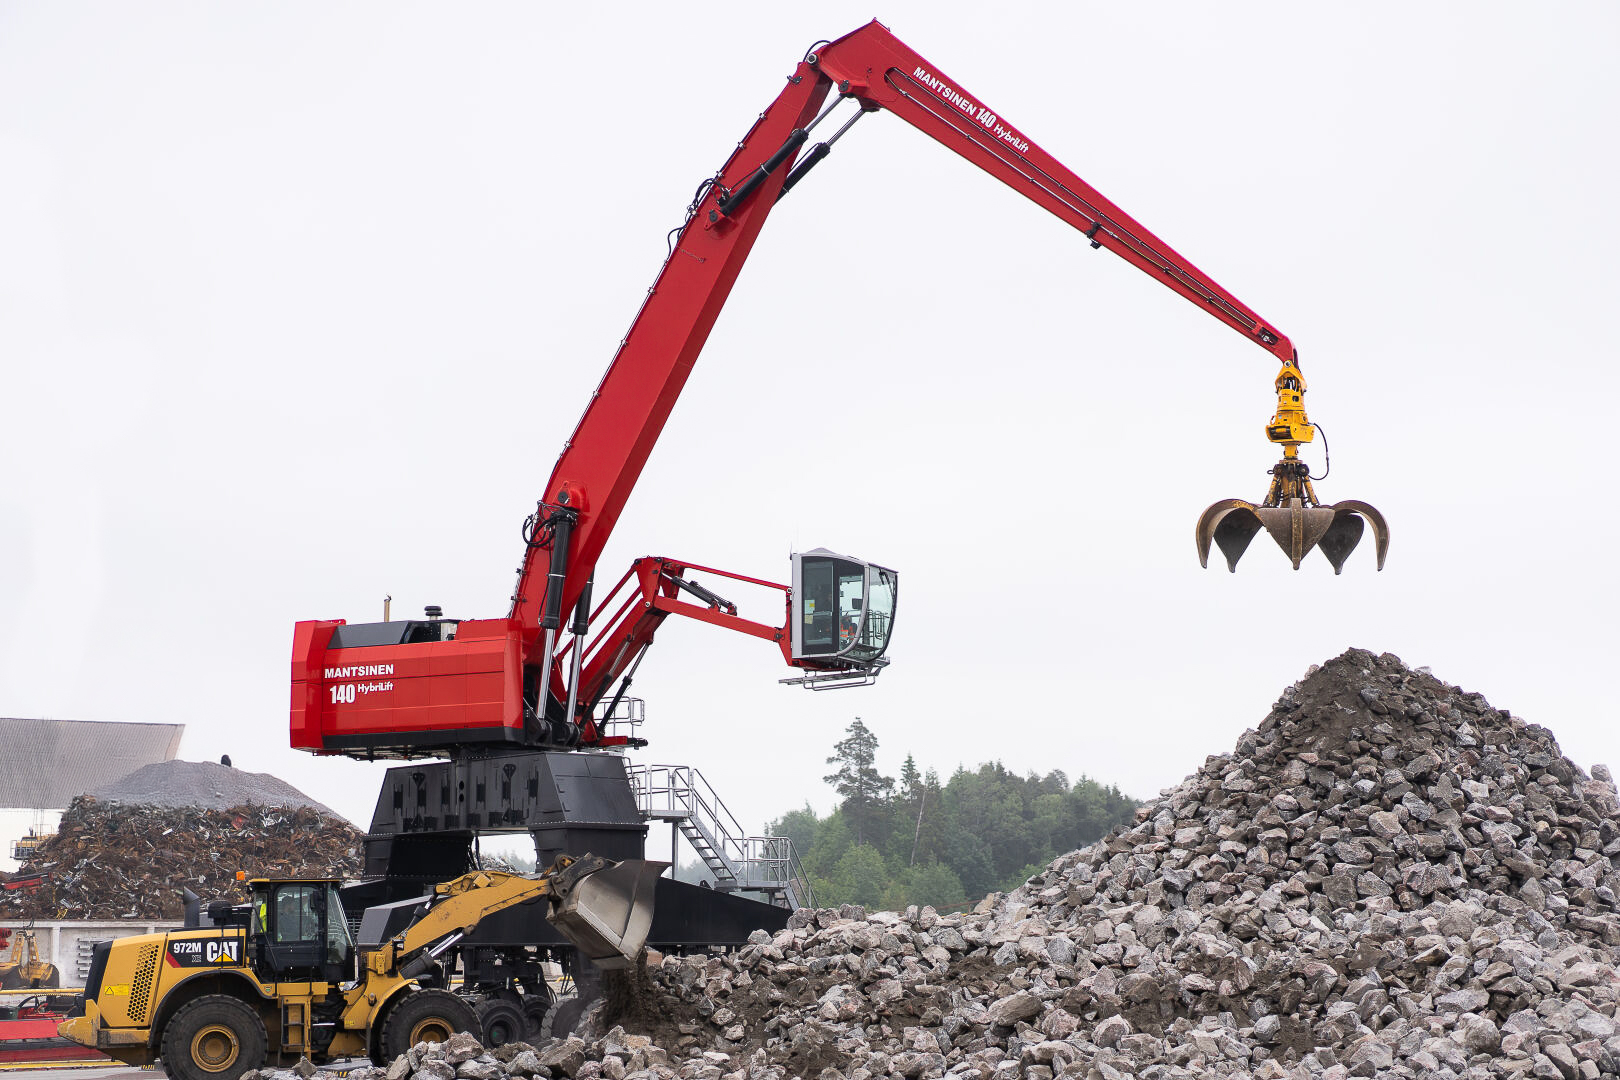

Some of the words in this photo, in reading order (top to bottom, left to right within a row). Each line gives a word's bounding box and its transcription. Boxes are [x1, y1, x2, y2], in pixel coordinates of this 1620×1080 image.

[913, 67, 976, 116] MANTSINEN
[976, 108, 996, 128] 140
[994, 124, 1029, 153] HybriLift
[325, 664, 393, 678] MANTSINEN
[330, 684, 355, 704] 140
[358, 681, 393, 694] HybriLift
[174, 943, 201, 953] 972M
[207, 942, 238, 962] CAT
